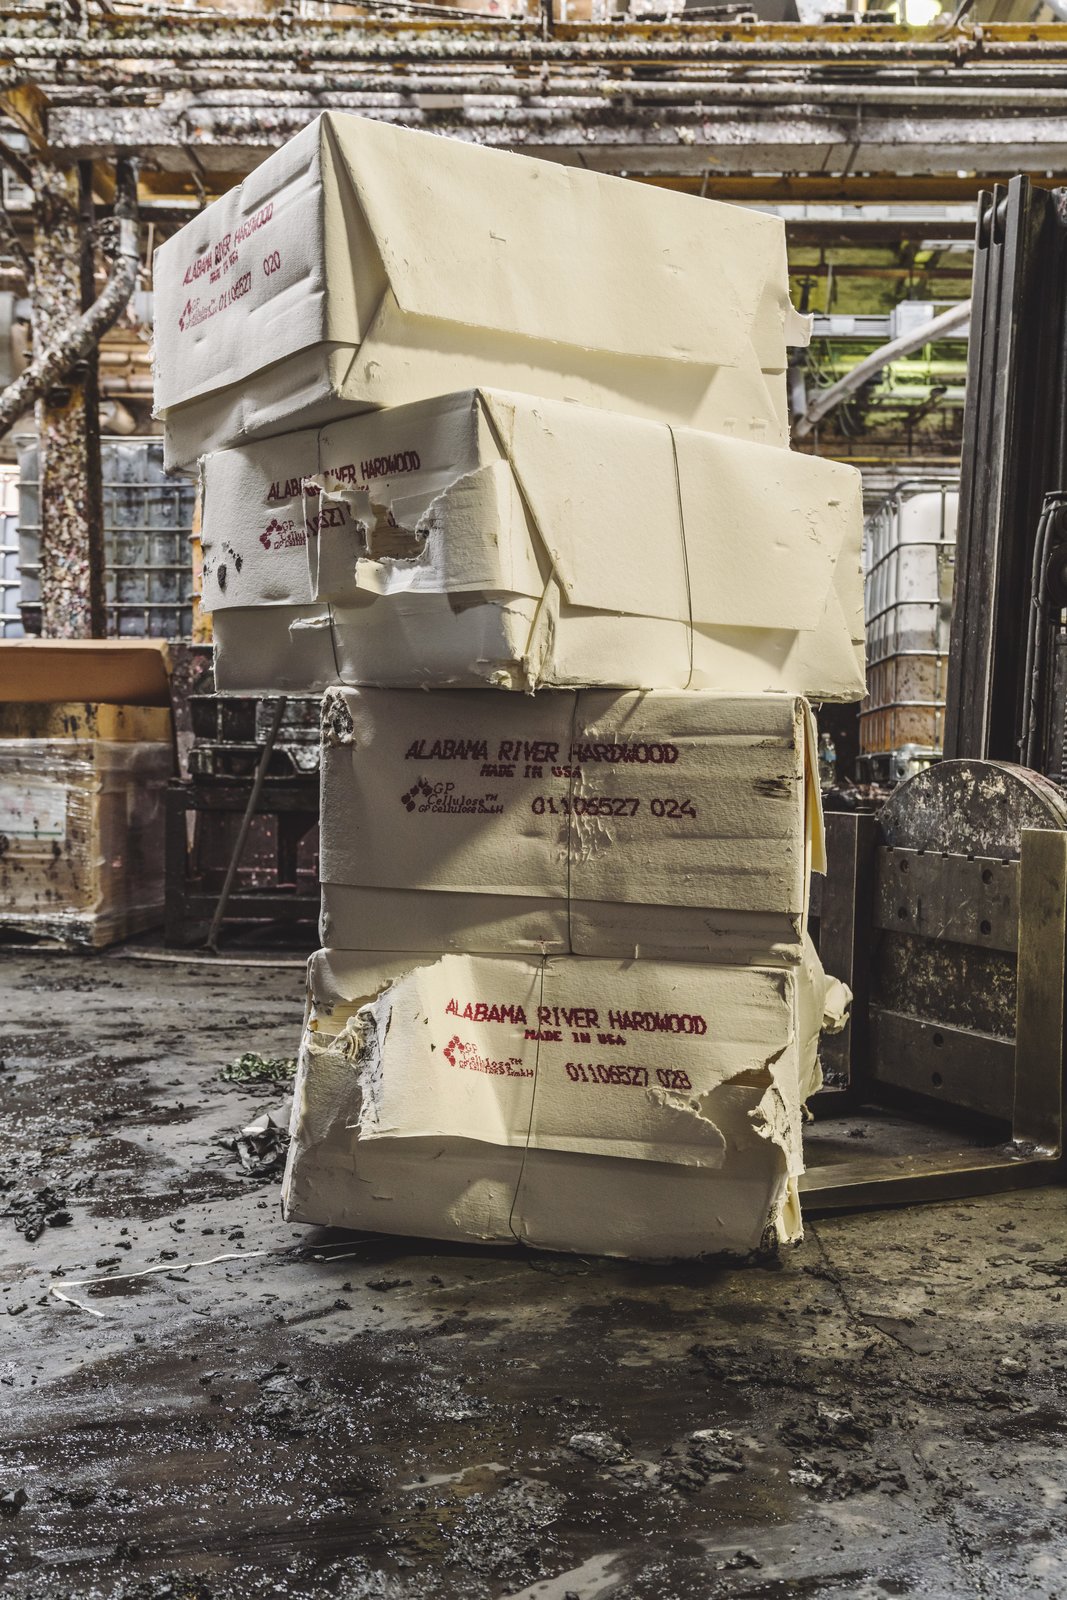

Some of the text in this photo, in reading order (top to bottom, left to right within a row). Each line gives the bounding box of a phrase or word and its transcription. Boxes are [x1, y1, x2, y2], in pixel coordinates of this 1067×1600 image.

[215, 234, 231, 266] RIVER
[234, 203, 273, 246] HARDWOOD
[219, 251, 280, 311] 01106527 020
[361, 450, 421, 480] HARDWOOD
[282, 520, 294, 531] GP
[405, 740, 679, 763] ALABAMA RIVER HARDWOOD
[480, 764, 582, 778] MADE IN USA
[433, 782, 455, 795] GP
[531, 797, 697, 818] 01106527 024
[445, 998, 707, 1035] ALABAMA RIVER HARDWOOD
[524, 1029, 626, 1045] MADE IN USA
[565, 1062, 692, 1090] 01106527 028
